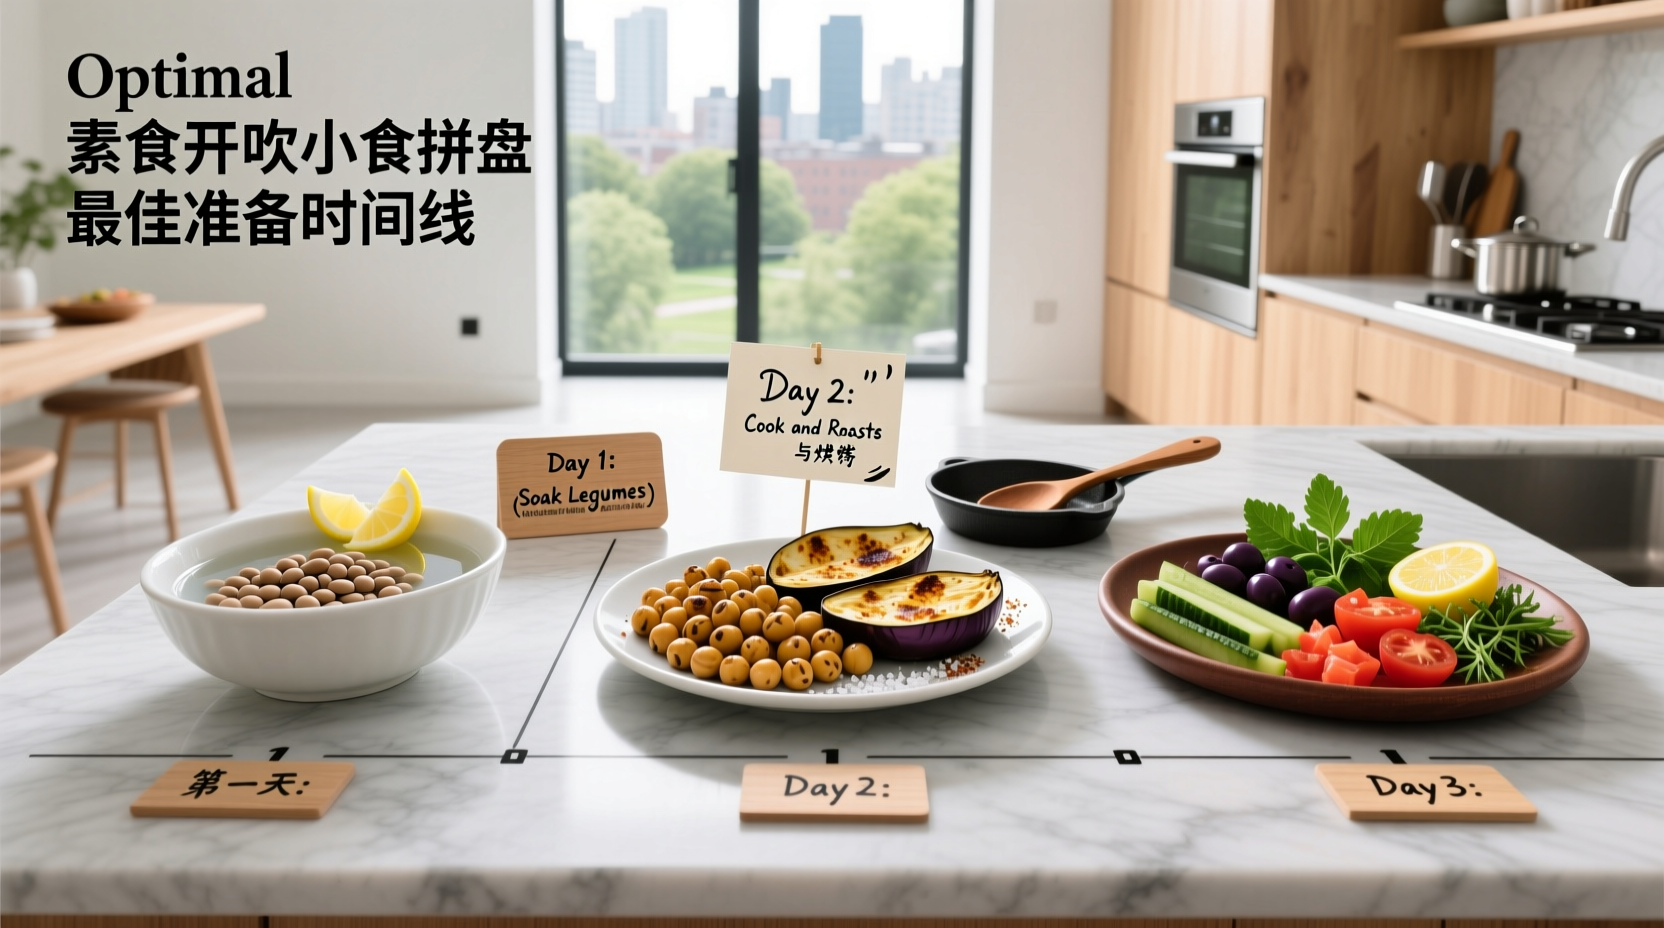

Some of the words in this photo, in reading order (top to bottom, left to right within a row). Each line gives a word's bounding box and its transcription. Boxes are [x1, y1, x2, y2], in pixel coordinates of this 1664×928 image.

[759, 368, 820, 417] Day
[827, 378, 854, 405] 2:
[744, 413, 785, 434] Cook
[791, 418, 822, 435] and
[546, 452, 590, 480] Day
[598, 449, 615, 471] 1:
[513, 486, 563, 519] (Soak
[568, 482, 655, 512] Legumes)
[783, 774, 849, 806] Day
[855, 776, 890, 798] 2:
[1365, 774, 1437, 805] Day
[1439, 775, 1483, 798] 3:
